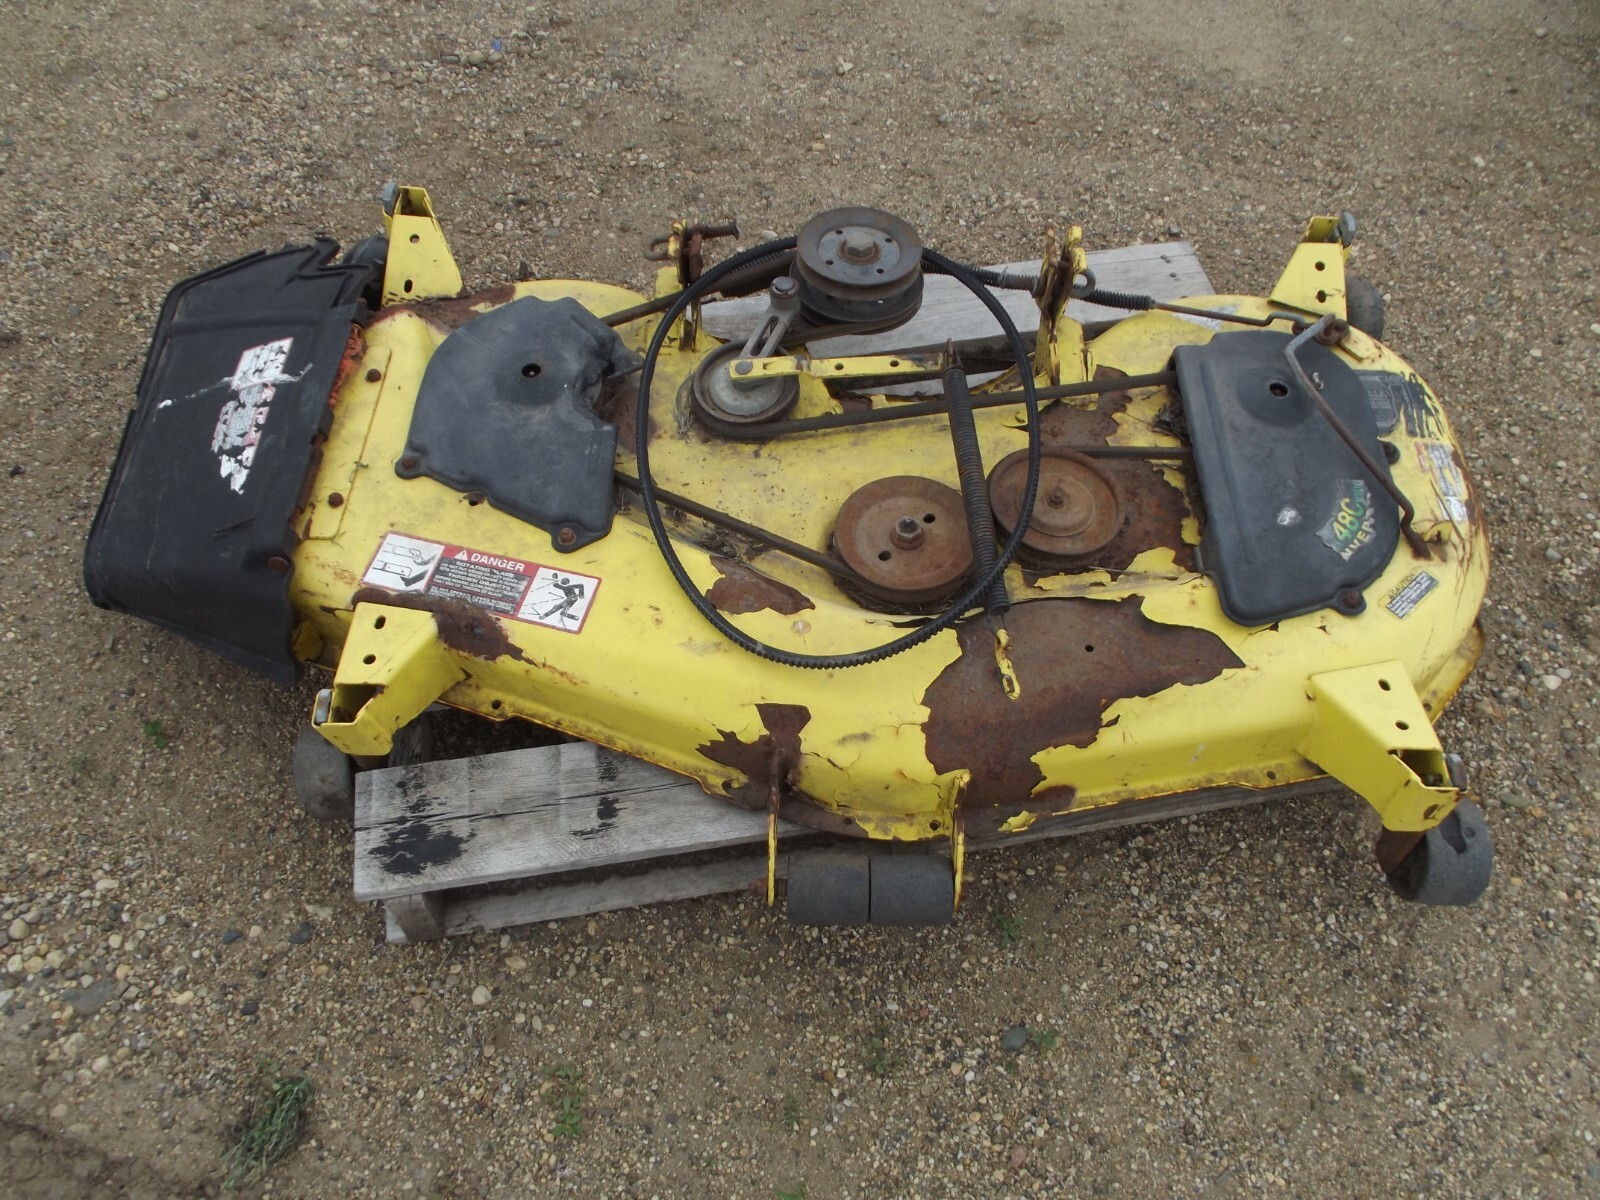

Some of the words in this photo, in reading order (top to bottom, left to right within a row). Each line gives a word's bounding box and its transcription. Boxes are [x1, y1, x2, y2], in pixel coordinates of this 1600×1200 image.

[1332, 498, 1364, 540] 48C
[456, 562, 491, 573] ROTATING
[471, 554, 526, 572] DANGER
[448, 573, 478, 583] THROWN
[479, 581, 511, 591] OBJECTS
[1391, 573, 1416, 596] CAUTION
